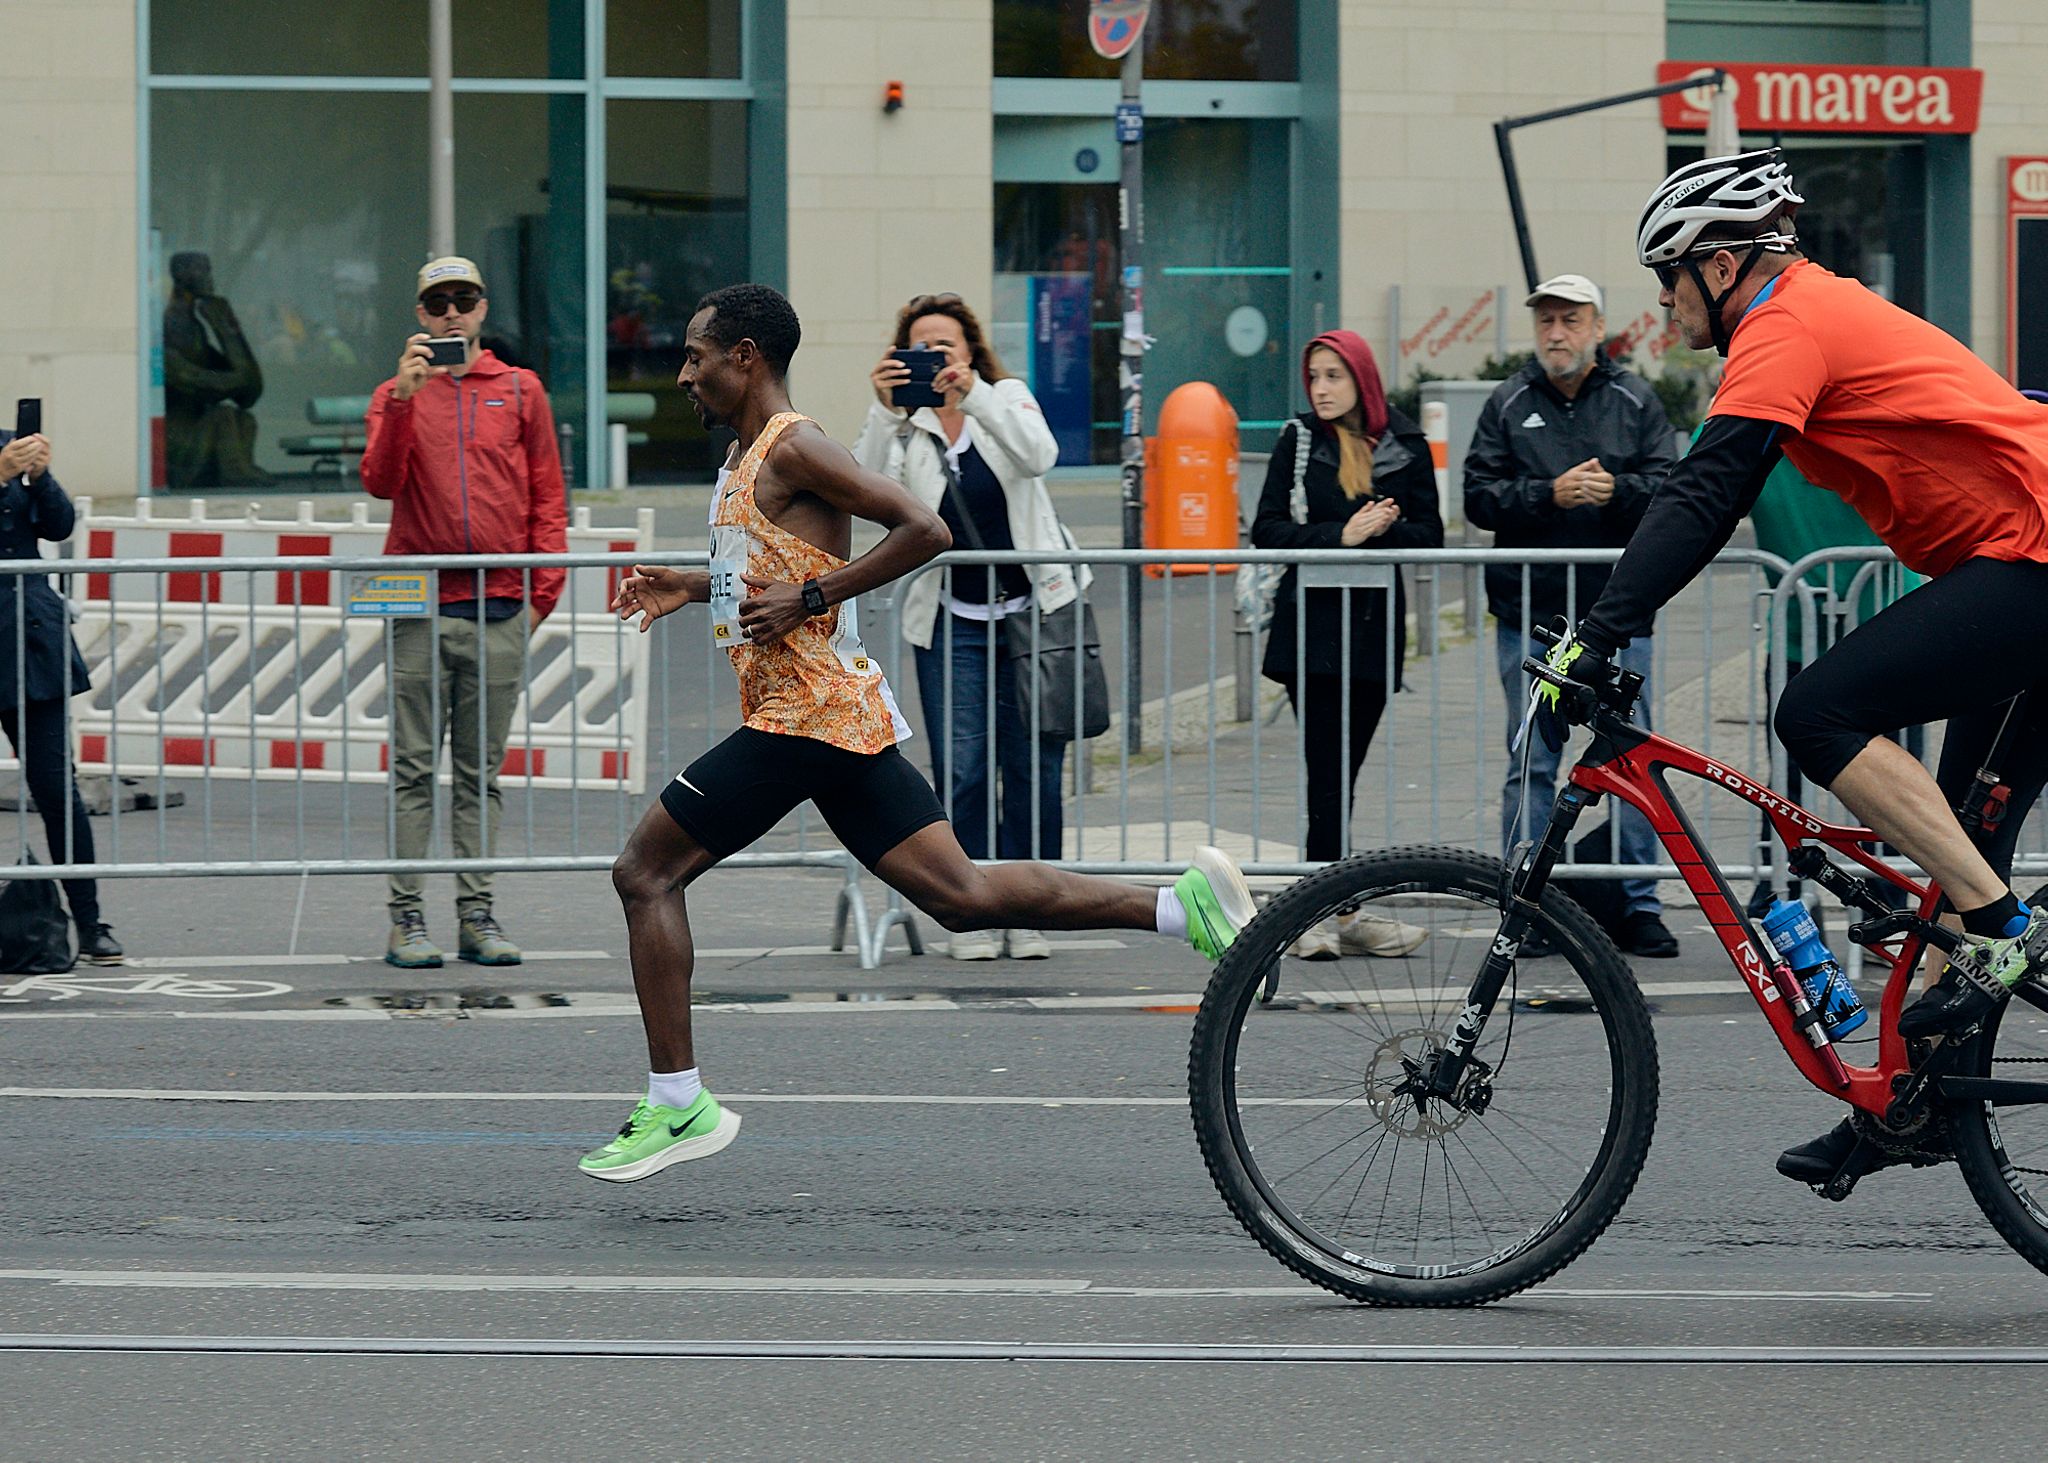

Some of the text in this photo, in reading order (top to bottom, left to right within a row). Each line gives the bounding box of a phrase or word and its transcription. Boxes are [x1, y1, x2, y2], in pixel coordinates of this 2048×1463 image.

[1755, 70, 1954, 125] marea
[1674, 178, 1706, 200] GIRO
[1705, 762, 1822, 835] ROTWILD
[1492, 933, 1519, 960] 34
[1445, 1002, 1486, 1057] FOX
[1362, 1258, 1397, 1274] SWISS
